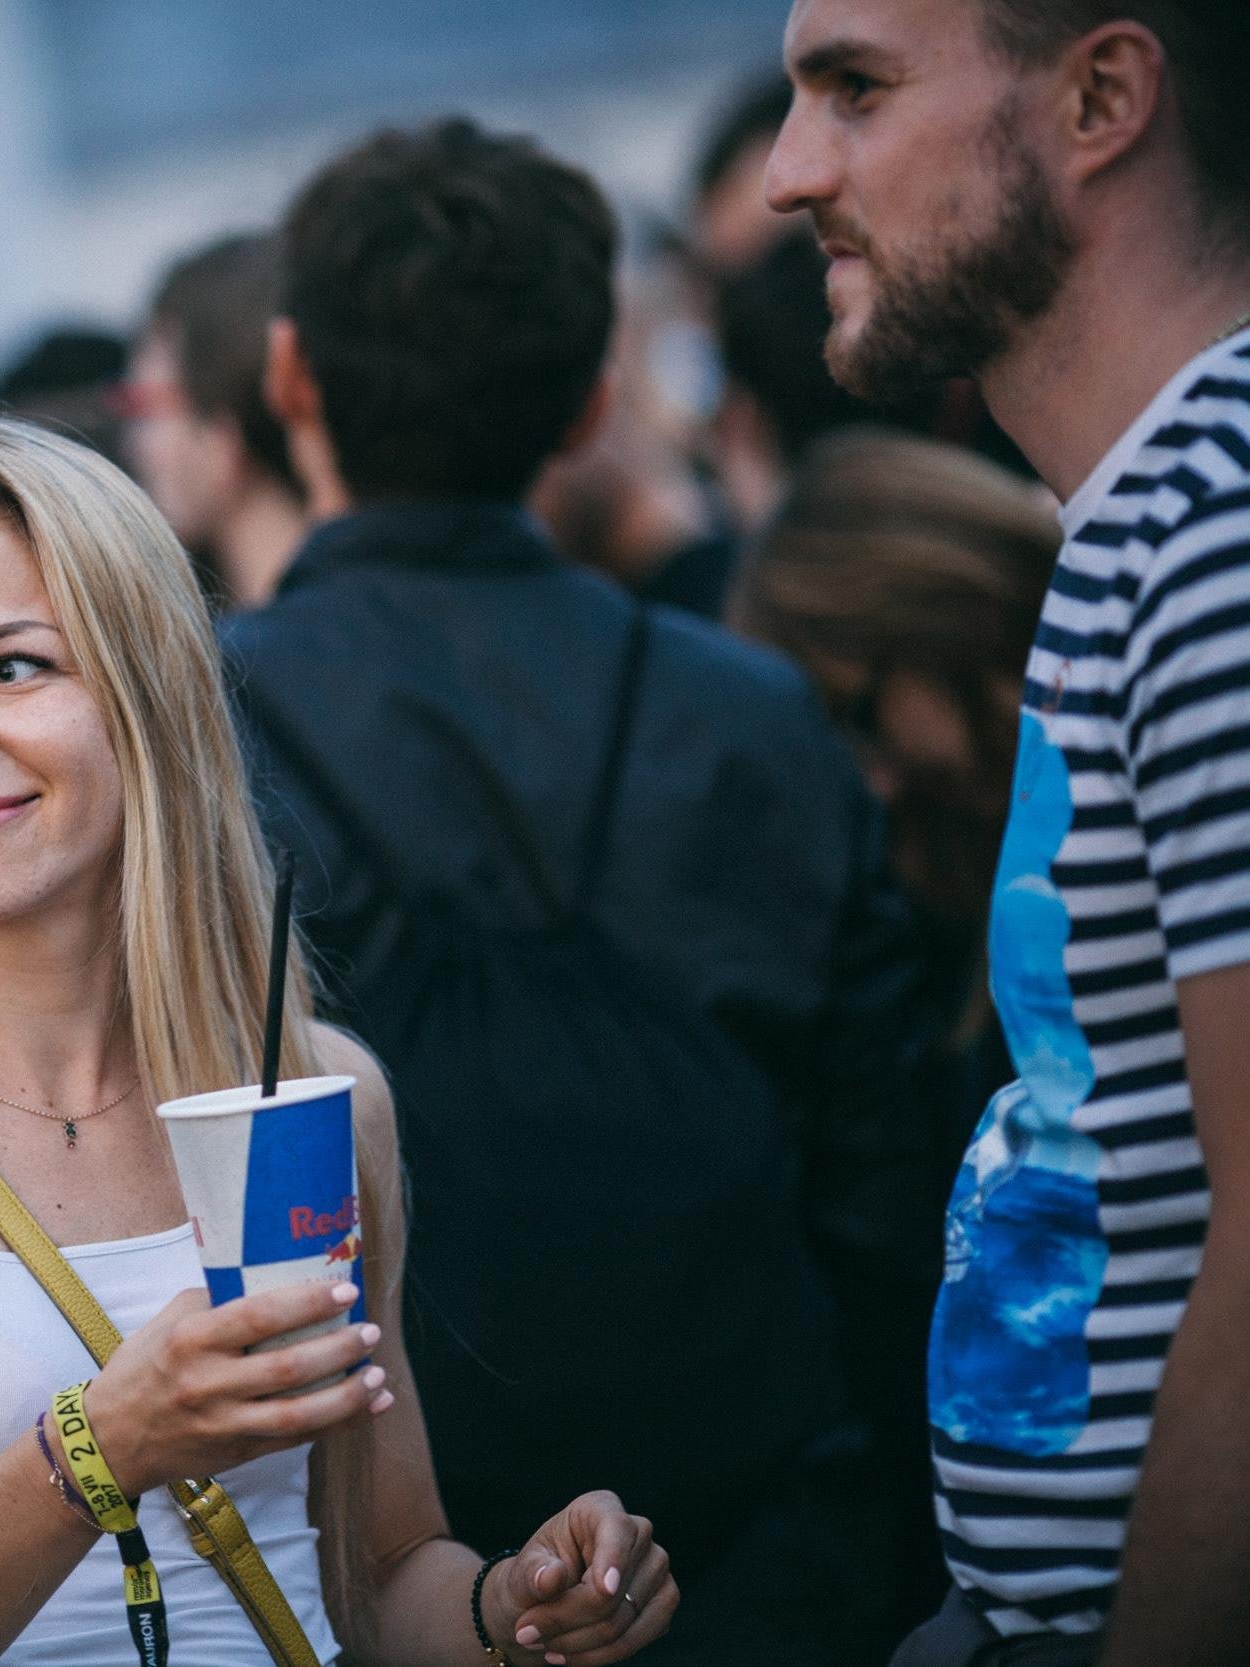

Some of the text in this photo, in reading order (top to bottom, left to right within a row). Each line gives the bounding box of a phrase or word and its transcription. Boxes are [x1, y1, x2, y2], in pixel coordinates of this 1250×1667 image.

[70, 1441, 96, 1461] 2
[80, 1475, 97, 1494] VII
[101, 1483, 124, 1509] 2017
